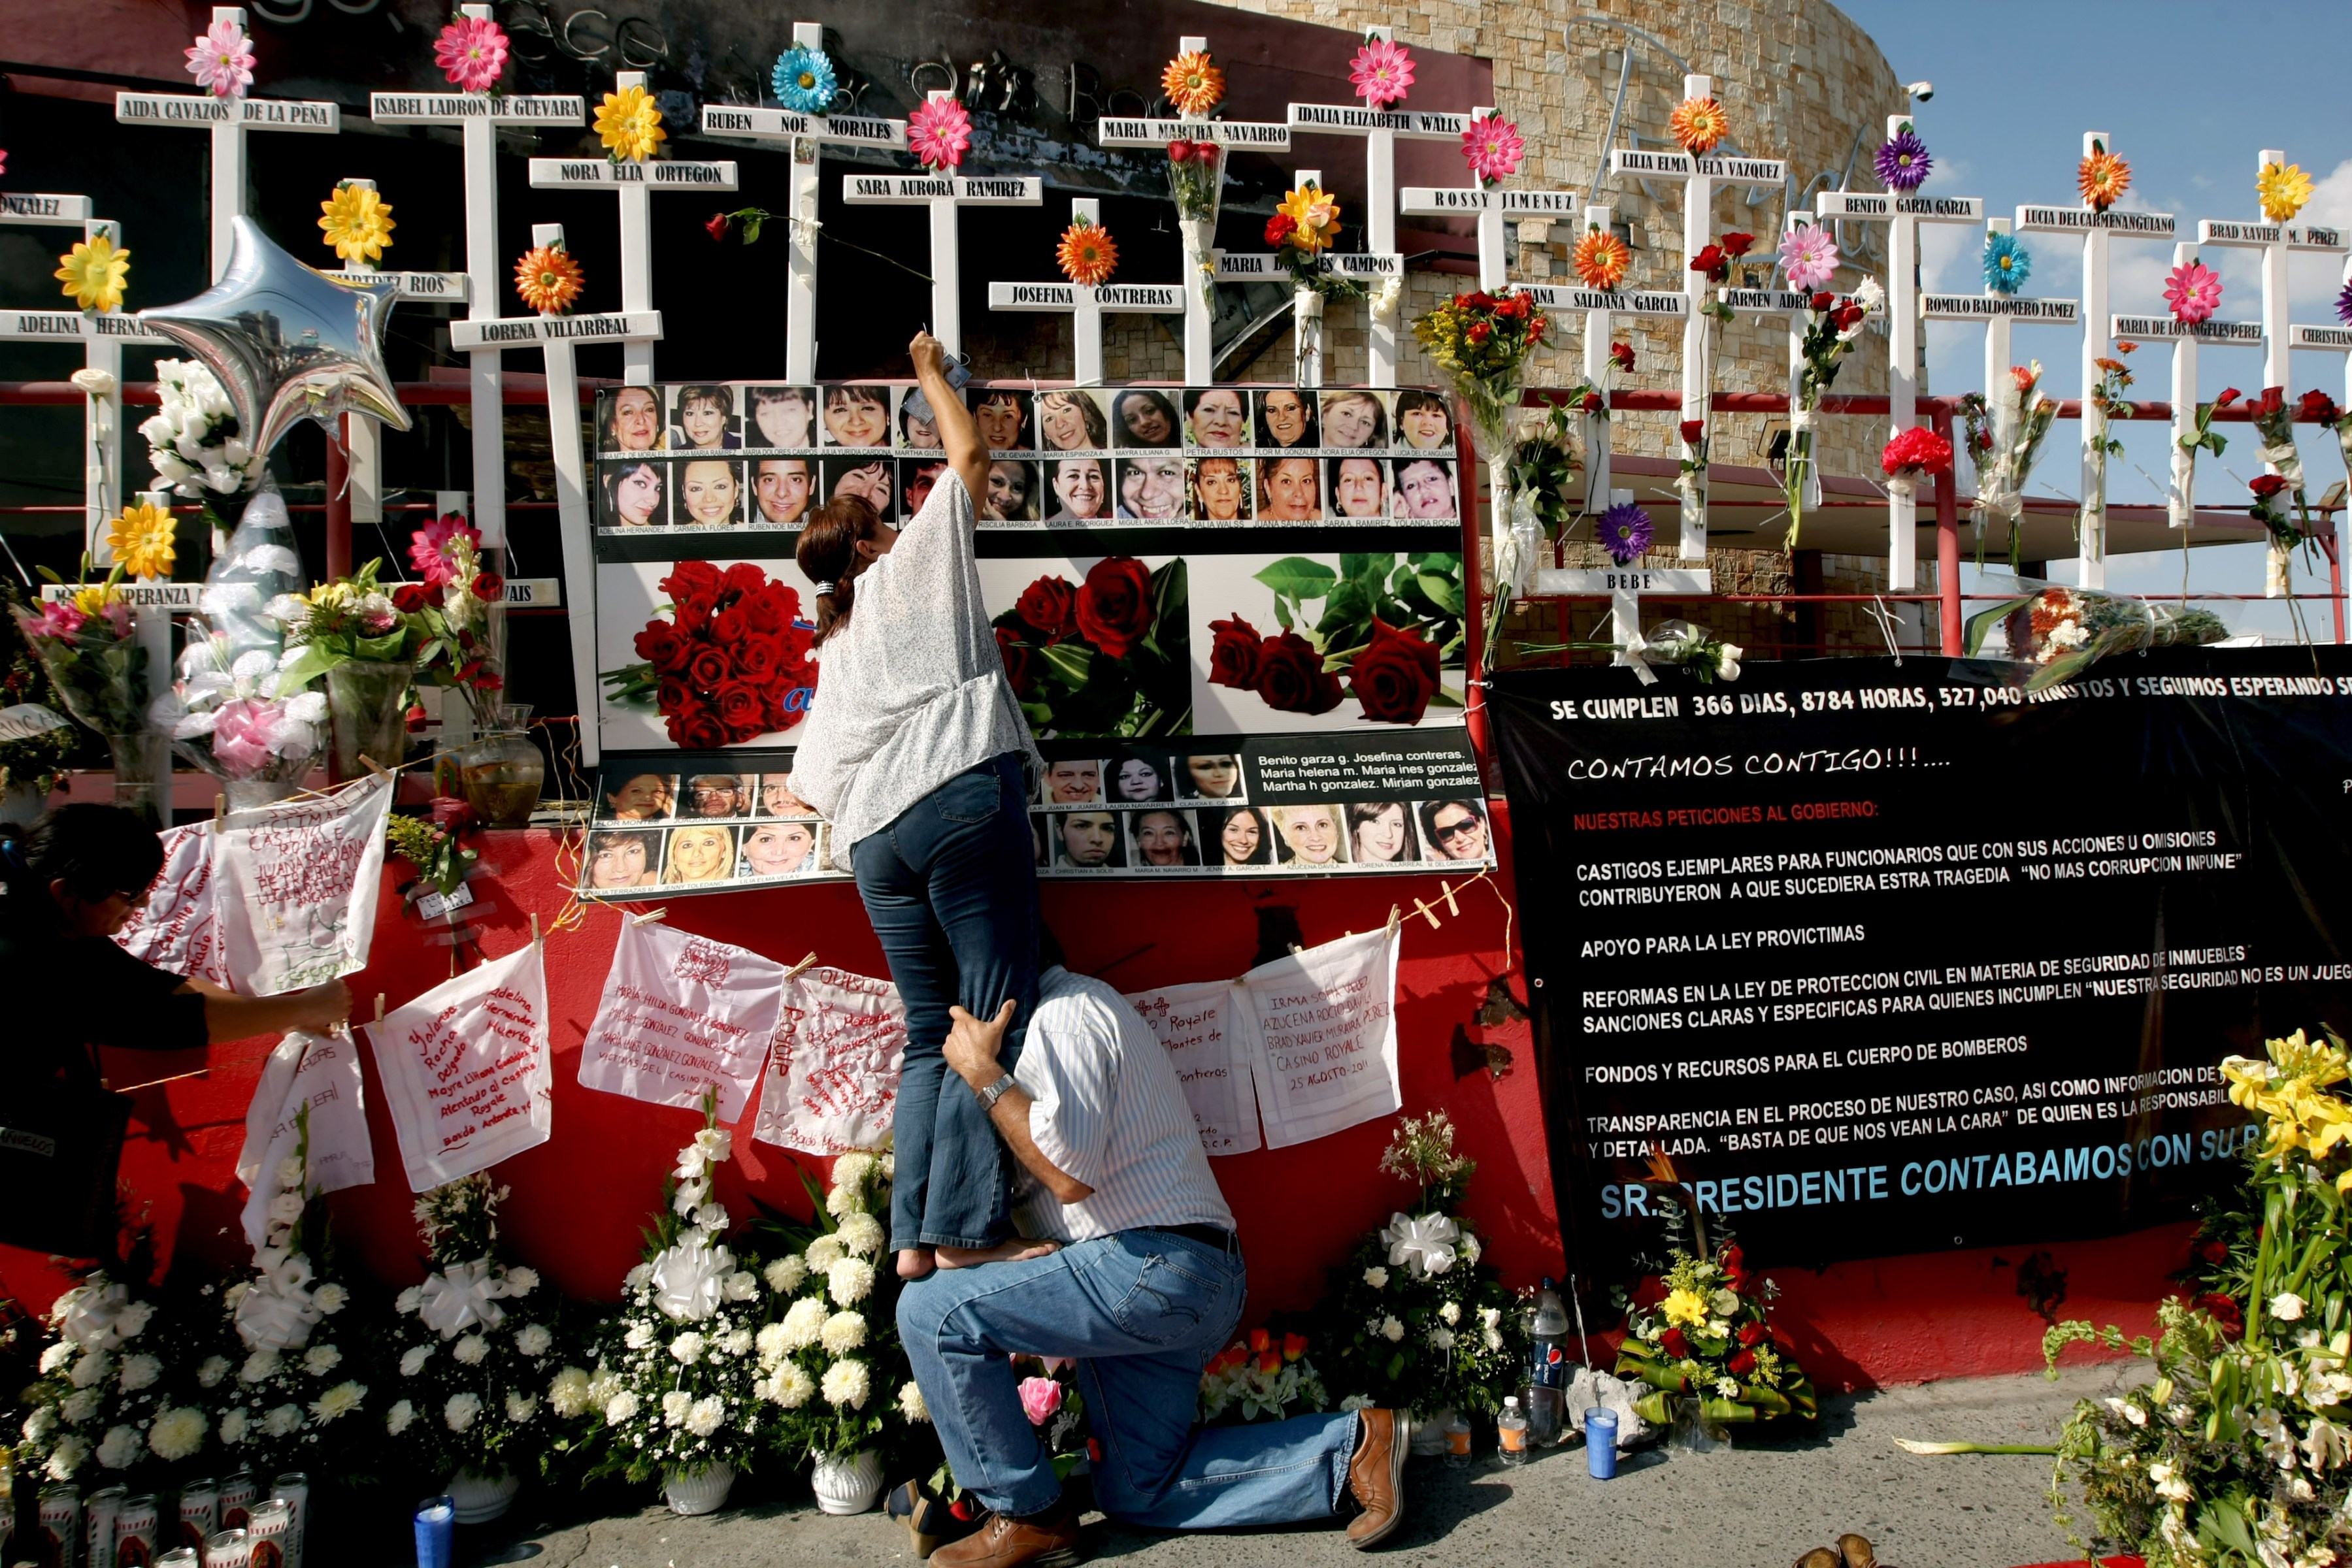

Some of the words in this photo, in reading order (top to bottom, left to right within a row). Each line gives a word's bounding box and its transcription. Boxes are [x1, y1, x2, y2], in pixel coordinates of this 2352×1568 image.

[123, 99, 159, 118] AIDA
[165, 101, 228, 120] CAVAZOS
[244, 103, 263, 121] DE
[267, 105, 284, 122] LA
[288, 104, 327, 125] PEÑA
[374, 97, 423, 115] ISABEL
[429, 98, 486, 116] LADRON
[491, 98, 509, 116] DE
[513, 98, 580, 118] GUEVARA
[706, 113, 752, 131] RUBEN
[781, 116, 808, 133] NOE
[828, 120, 891, 139] MORALES
[1297, 106, 1340, 125] IDALIA
[1344, 110, 1410, 129] ELIZABETH
[1421, 116, 1461, 133] WALLS
[1104, 122, 1148, 139] MARIA
[1158, 123, 1215, 140] MARTHA
[1223, 125, 1287, 142] NAVARRO
[561, 164, 600, 180] NORA
[613, 165, 644, 180] ELIA
[655, 165, 721, 182] ORTEGON
[1623, 153, 1653, 169] LILIA
[1657, 156, 1687, 172] ELMA
[1695, 159, 1723, 175] VELA
[1729, 161, 1779, 178] VAZQUEZ
[856, 178, 891, 196] SARA
[900, 179, 954, 197] AURORA
[967, 180, 1025, 197] RAMIREZ
[0, 198, 59, 217] ONZALEZ
[1435, 191, 1489, 208] ROSSY
[1502, 192, 1572, 210] JIMENEZ
[1846, 198, 1887, 214] BENITO
[1897, 199, 1932, 215] GARZA
[1935, 200, 1971, 215] GARZA
[2025, 209, 2055, 224] LUCIA
[2059, 212, 2078, 226] DEL
[2210, 224, 2238, 238] BRAD
[2242, 226, 2279, 242] XAVIER
[2289, 229, 2300, 244] M.
[2308, 231, 2338, 246] PEREZ
[1221, 256, 1262, 274] MARIA
[1342, 255, 1395, 274] CAMPOS
[410, 276, 444, 293] RIOS
[1012, 286, 1073, 303] JOSEFINA
[1095, 287, 1173, 305] CONTRERAS
[1574, 293, 1626, 310] SALDAÑA
[1635, 297, 1678, 312] GARCIA
[1729, 291, 1770, 307] CARMEN
[1925, 298, 1970, 314] ROMULO
[1973, 299, 2040, 317] BALDOMERO
[2042, 302, 2075, 318] TAMEZ
[18, 316, 80, 333] ADELINA
[481, 323, 537, 342] LORENA
[544, 318, 631, 338] VILLARREAL
[2117, 319, 2149, 335] MARIA
[2152, 320, 2166, 335] DE
[2230, 323, 2262, 339] PEREZ
[1607, 574, 1650, 589] BEBE
[1550, 700, 1578, 720] SE
[1583, 696, 1678, 719] CUMPLEN
[1693, 695, 1733, 715] 366
[1740, 692, 1795, 718] DIAS,
[1801, 691, 1854, 711] 8784
[1859, 687, 1934, 713] HORAS,
[2119, 678, 2129, 696] Y
[2137, 676, 2228, 696] SEGUIMOS
[2230, 676, 2334, 696] ESPERANDO
[1258, 756, 1297, 766] Benito
[1300, 755, 1335, 766] garza
[1338, 755, 1350, 765] g.
[1353, 753, 1403, 763] Josefina
[1406, 750, 1465, 761] contreras.
[1568, 755, 1732, 779] CONTAMOS
[1261, 768, 1295, 778] Maria
[1299, 766, 1340, 777] helena
[1344, 767, 1359, 776] m.
[1362, 765, 1396, 775] Maria
[1399, 764, 1423, 774] ines
[1427, 762, 1478, 776] gonzalez
[1263, 781, 1306, 791] Martha
[1310, 780, 1317, 790] h
[1321, 779, 1379, 792] gonzalez.
[1383, 778, 1423, 788] Miriam
[1426, 776, 1480, 789] gonzalez
[1575, 811, 1662, 830] NUESTRAS
[1668, 806, 1761, 825] PETICIONES
[1768, 806, 1787, 821] AL
[1791, 800, 1880, 820] GOBIERNO:
[1577, 861, 1662, 881] CASTIGOS
[1667, 855, 1774, 877] EJEMPLARES
[1778, 853, 1822, 870] PARA
[1826, 846, 1942, 868] FUNCIONARIOS
[1947, 844, 1978, 861] QUE
[1982, 842, 2013, 858] CON
[2017, 840, 2047, 857] SUS
[2052, 836, 2125, 855] ACCIONES
[2128, 835, 2138, 850] U
[2142, 831, 2215, 849] OMISIONES
[1580, 883, 1721, 906] CONTRIBUYERON
[1731, 883, 1742, 898] A
[1746, 880, 1780, 898] QUE
[1785, 875, 1876, 895] SUCEDIERA
[1880, 872, 1930, 889] ESTRA
[1934, 867, 2010, 886] TRAGEDIA
[2055, 862, 2085, 878] MAS
[2089, 856, 2181, 876] CORRUPCION
[1581, 938, 1640, 957] APOYO
[1646, 936, 1691, 954] PARA
[1696, 934, 1717, 951] LA
[1722, 932, 1751, 949] LEY
[1757, 924, 1864, 947] PROVICTIMAS
[1602, 1184, 1657, 1218] SR.
[1674, 1165, 1889, 1214] RESIDENTE
[1901, 1143, 2131, 1195] CONTABAMOS
[2138, 1134, 2191, 1168] CON
[2201, 1128, 2238, 1160] SU
